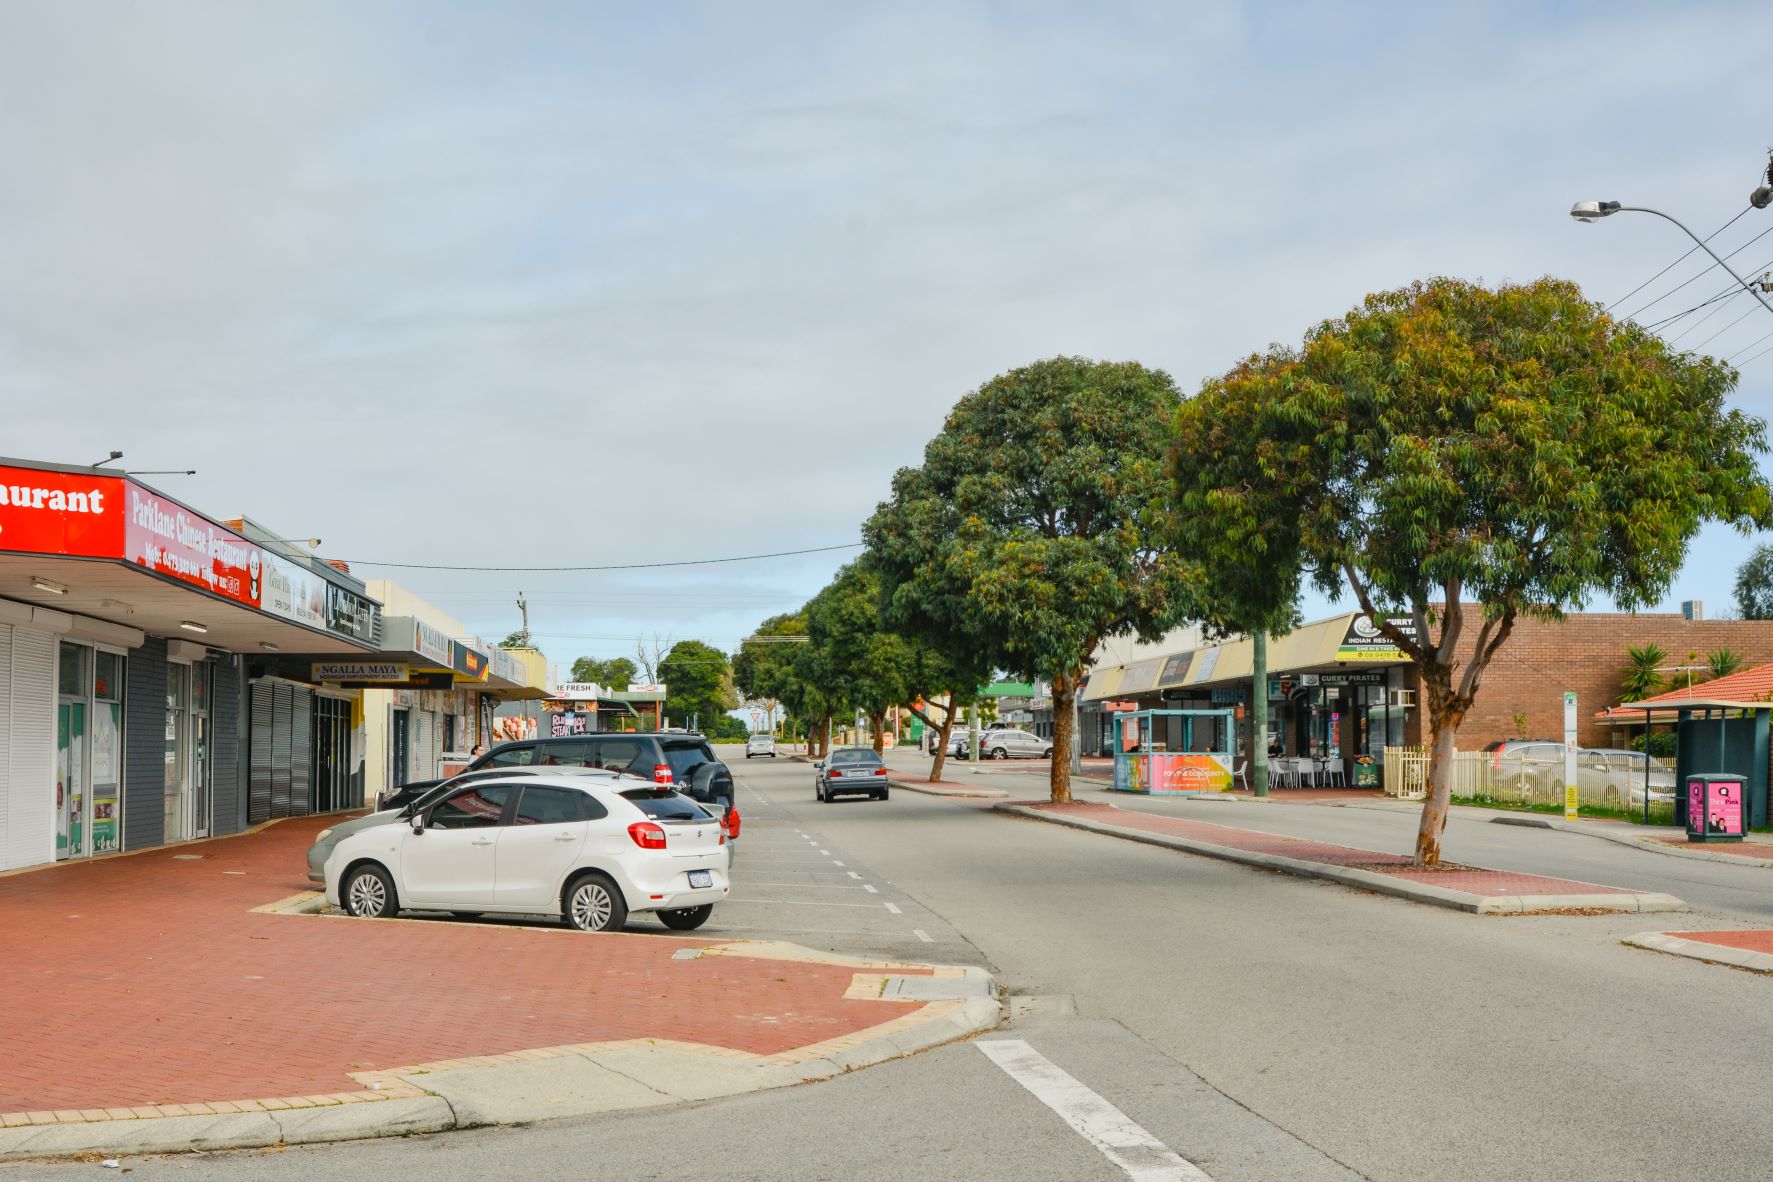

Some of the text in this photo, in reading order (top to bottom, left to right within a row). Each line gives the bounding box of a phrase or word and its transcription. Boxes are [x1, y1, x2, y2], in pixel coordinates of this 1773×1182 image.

[132, 490, 247, 572] Parklane Chinese Restaurant
[322, 665, 397, 674] NGALLA MAYA
